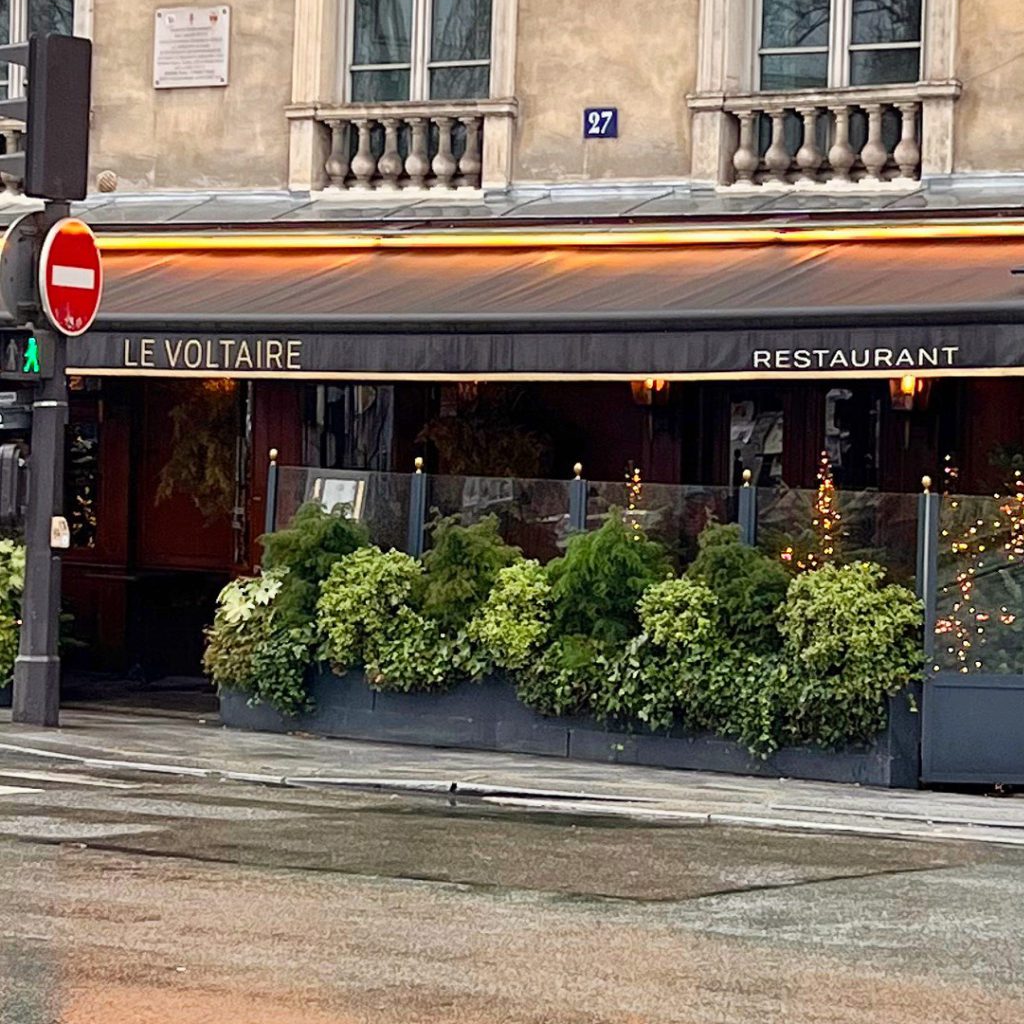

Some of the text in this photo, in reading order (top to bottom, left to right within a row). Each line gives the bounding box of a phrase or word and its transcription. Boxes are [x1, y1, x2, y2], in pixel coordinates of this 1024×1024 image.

[588, 111, 613, 134] 27
[124, 338, 303, 369] LE VOLTAIRE
[753, 346, 959, 369] RESTAURANT
